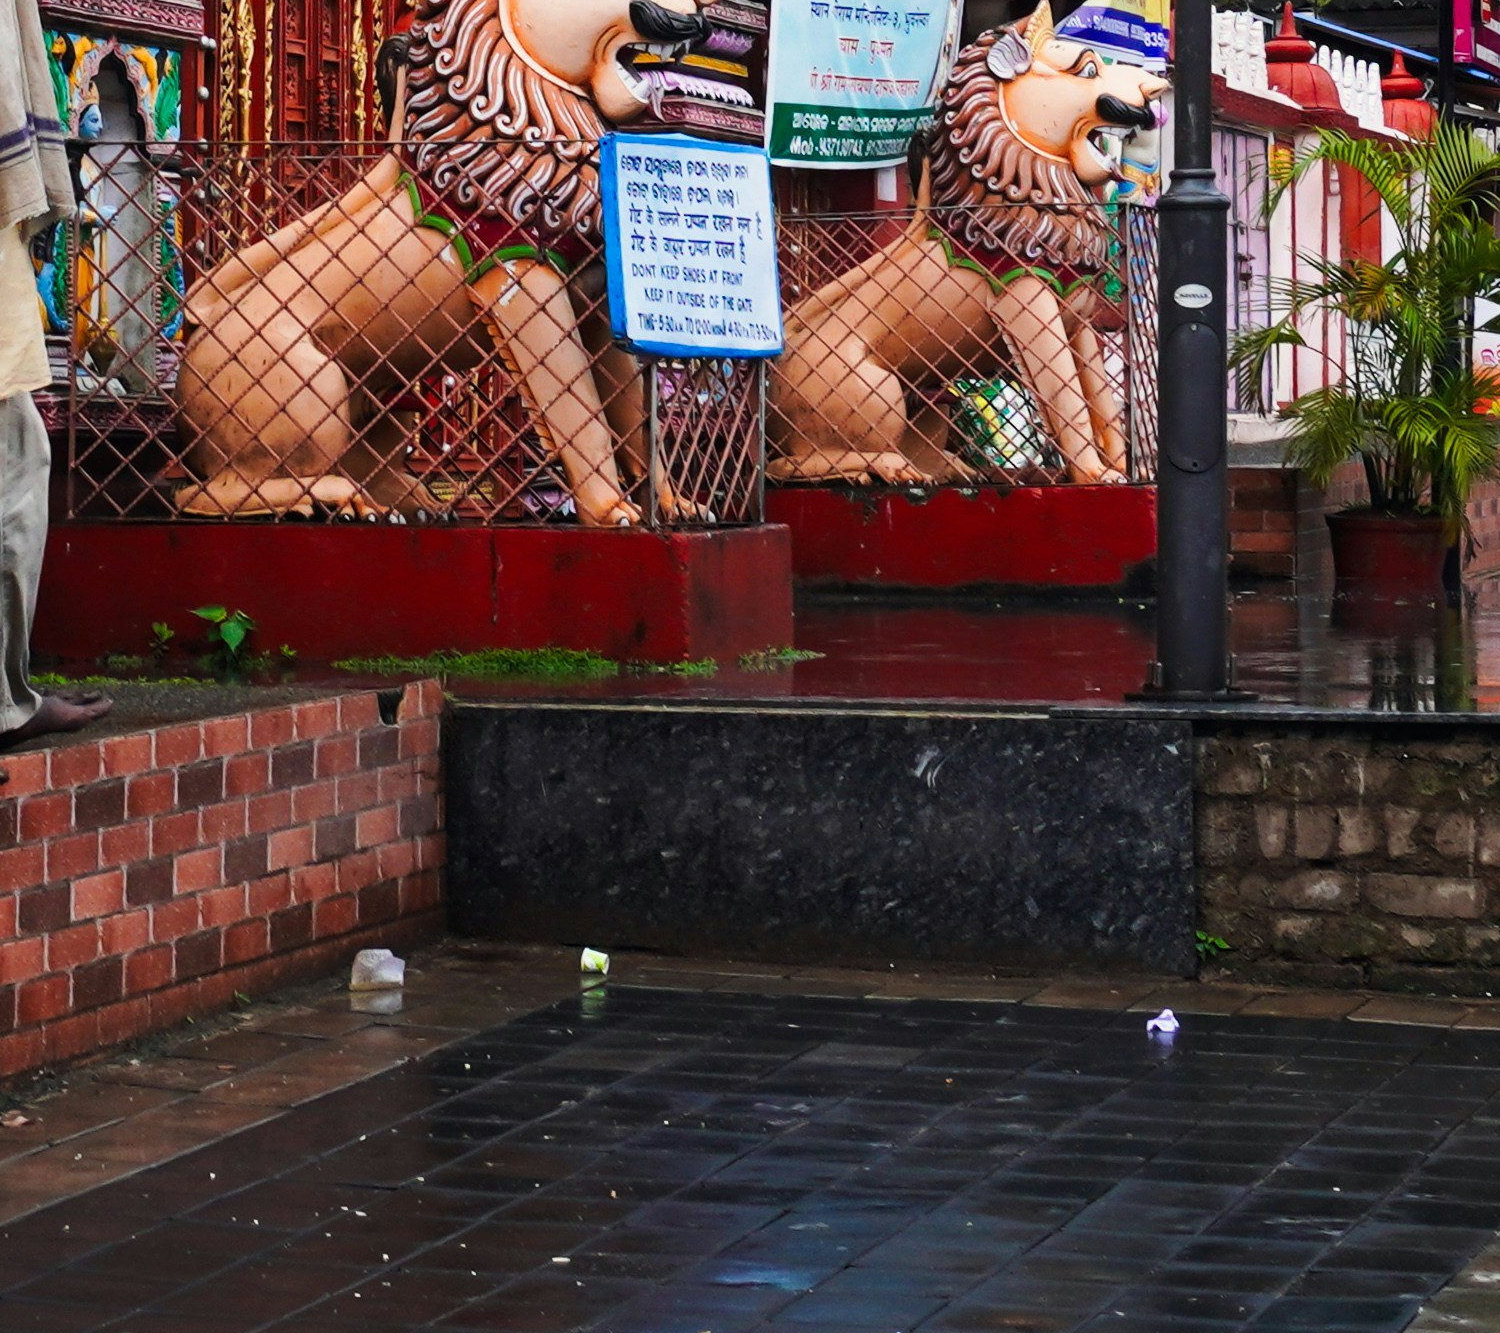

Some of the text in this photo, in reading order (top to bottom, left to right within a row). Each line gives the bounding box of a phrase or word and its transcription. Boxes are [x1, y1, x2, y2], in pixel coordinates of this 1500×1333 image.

[632, 263, 743, 286] DONT KEEP SHOES AT FRONT
[644, 287, 753, 313] KEEP IT OUTSIDE OF THE GATE
